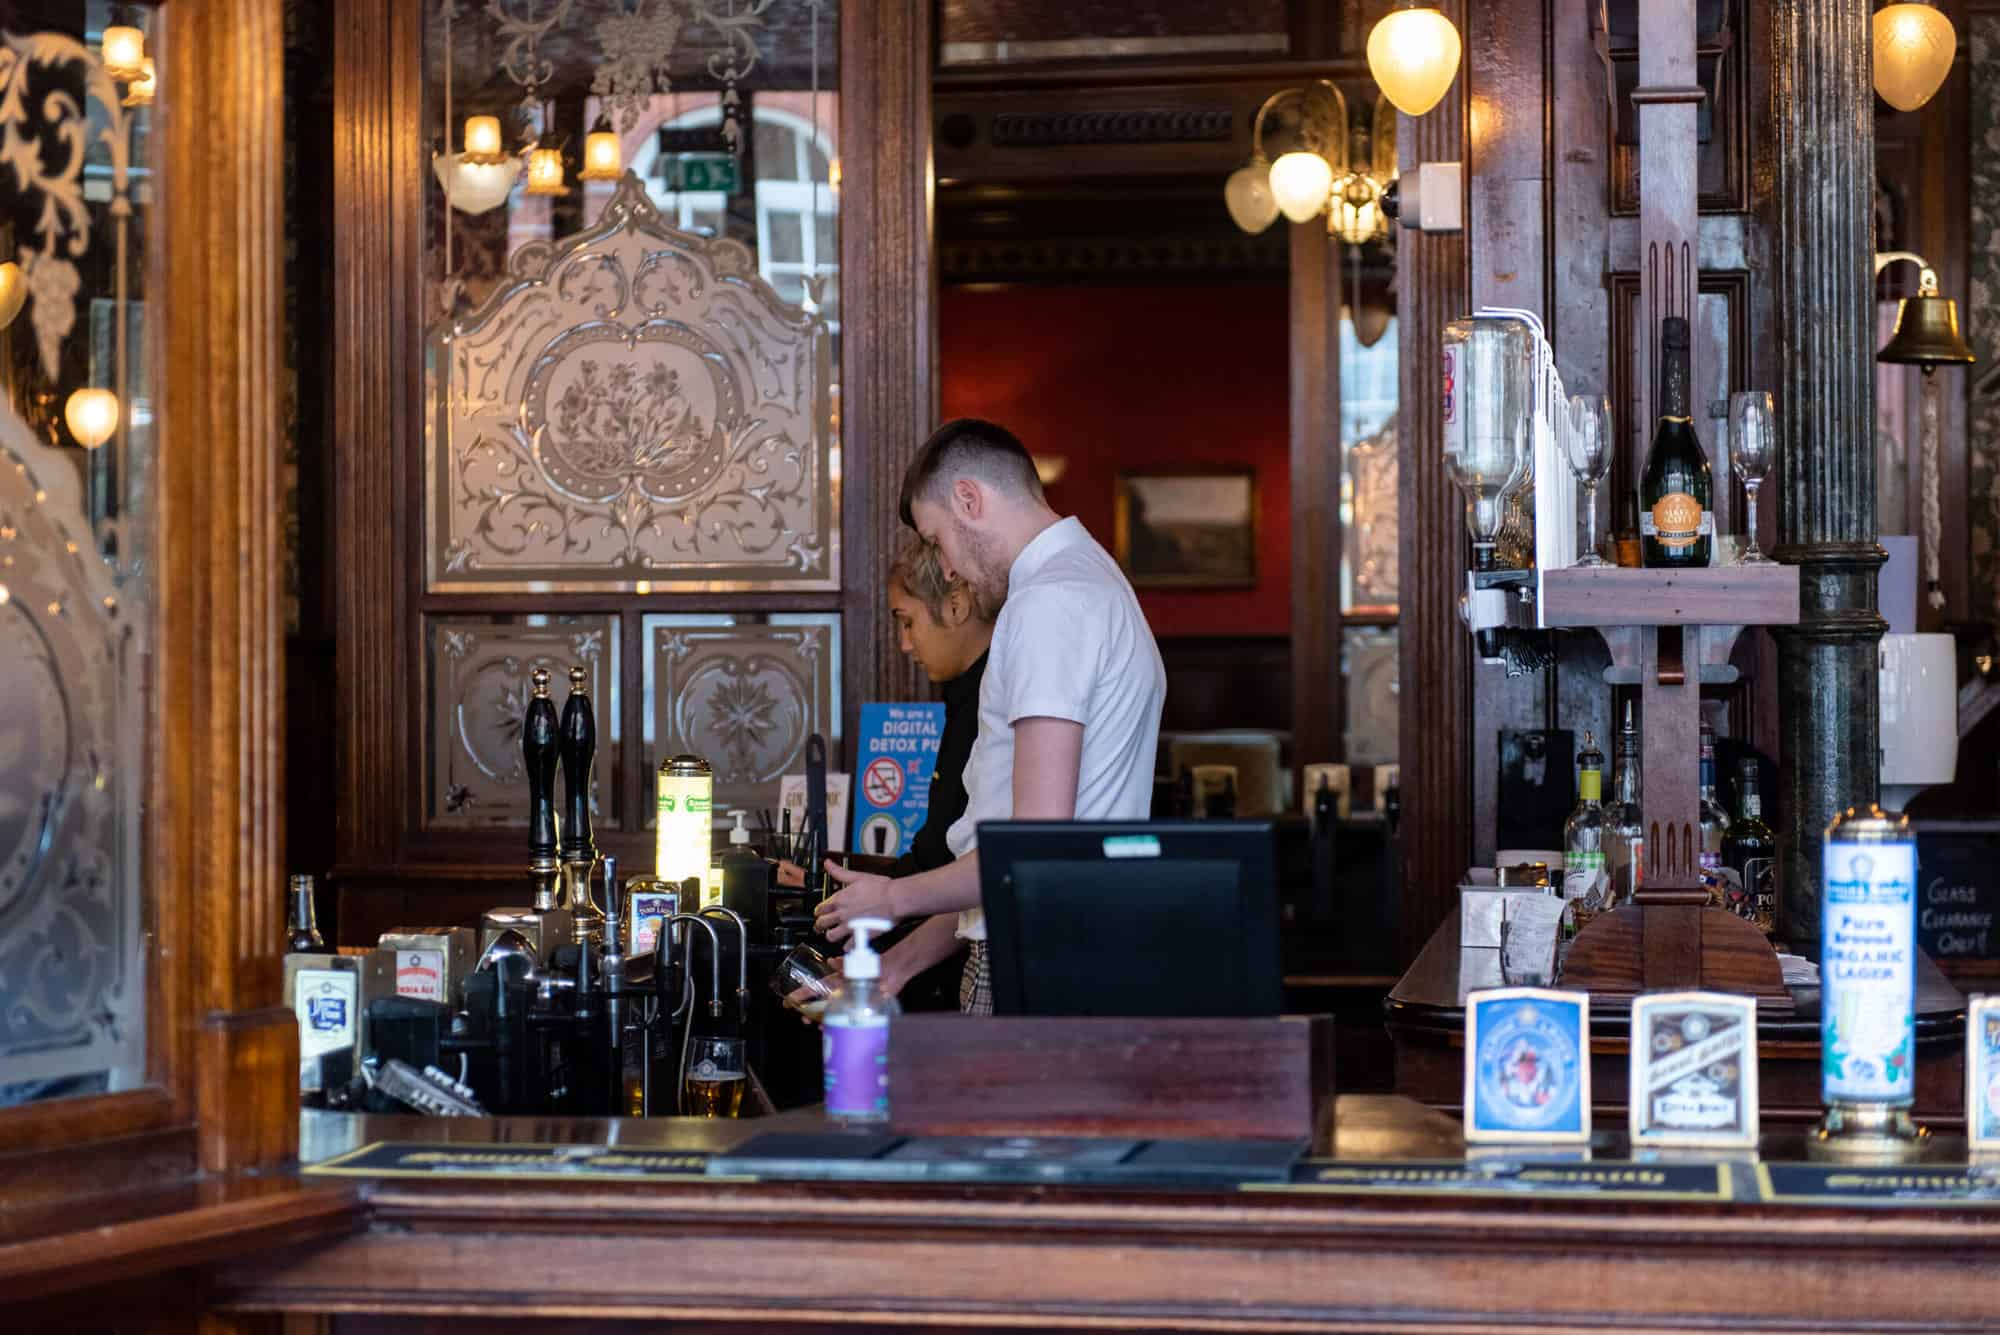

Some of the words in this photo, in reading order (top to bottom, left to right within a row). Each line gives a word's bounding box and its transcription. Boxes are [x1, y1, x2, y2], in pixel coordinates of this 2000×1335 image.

[883, 721, 937, 735] DIGITAL
[869, 738, 917, 752] DETOX
[921, 737, 941, 752] PU
[1757, 893, 1774, 906] PO
